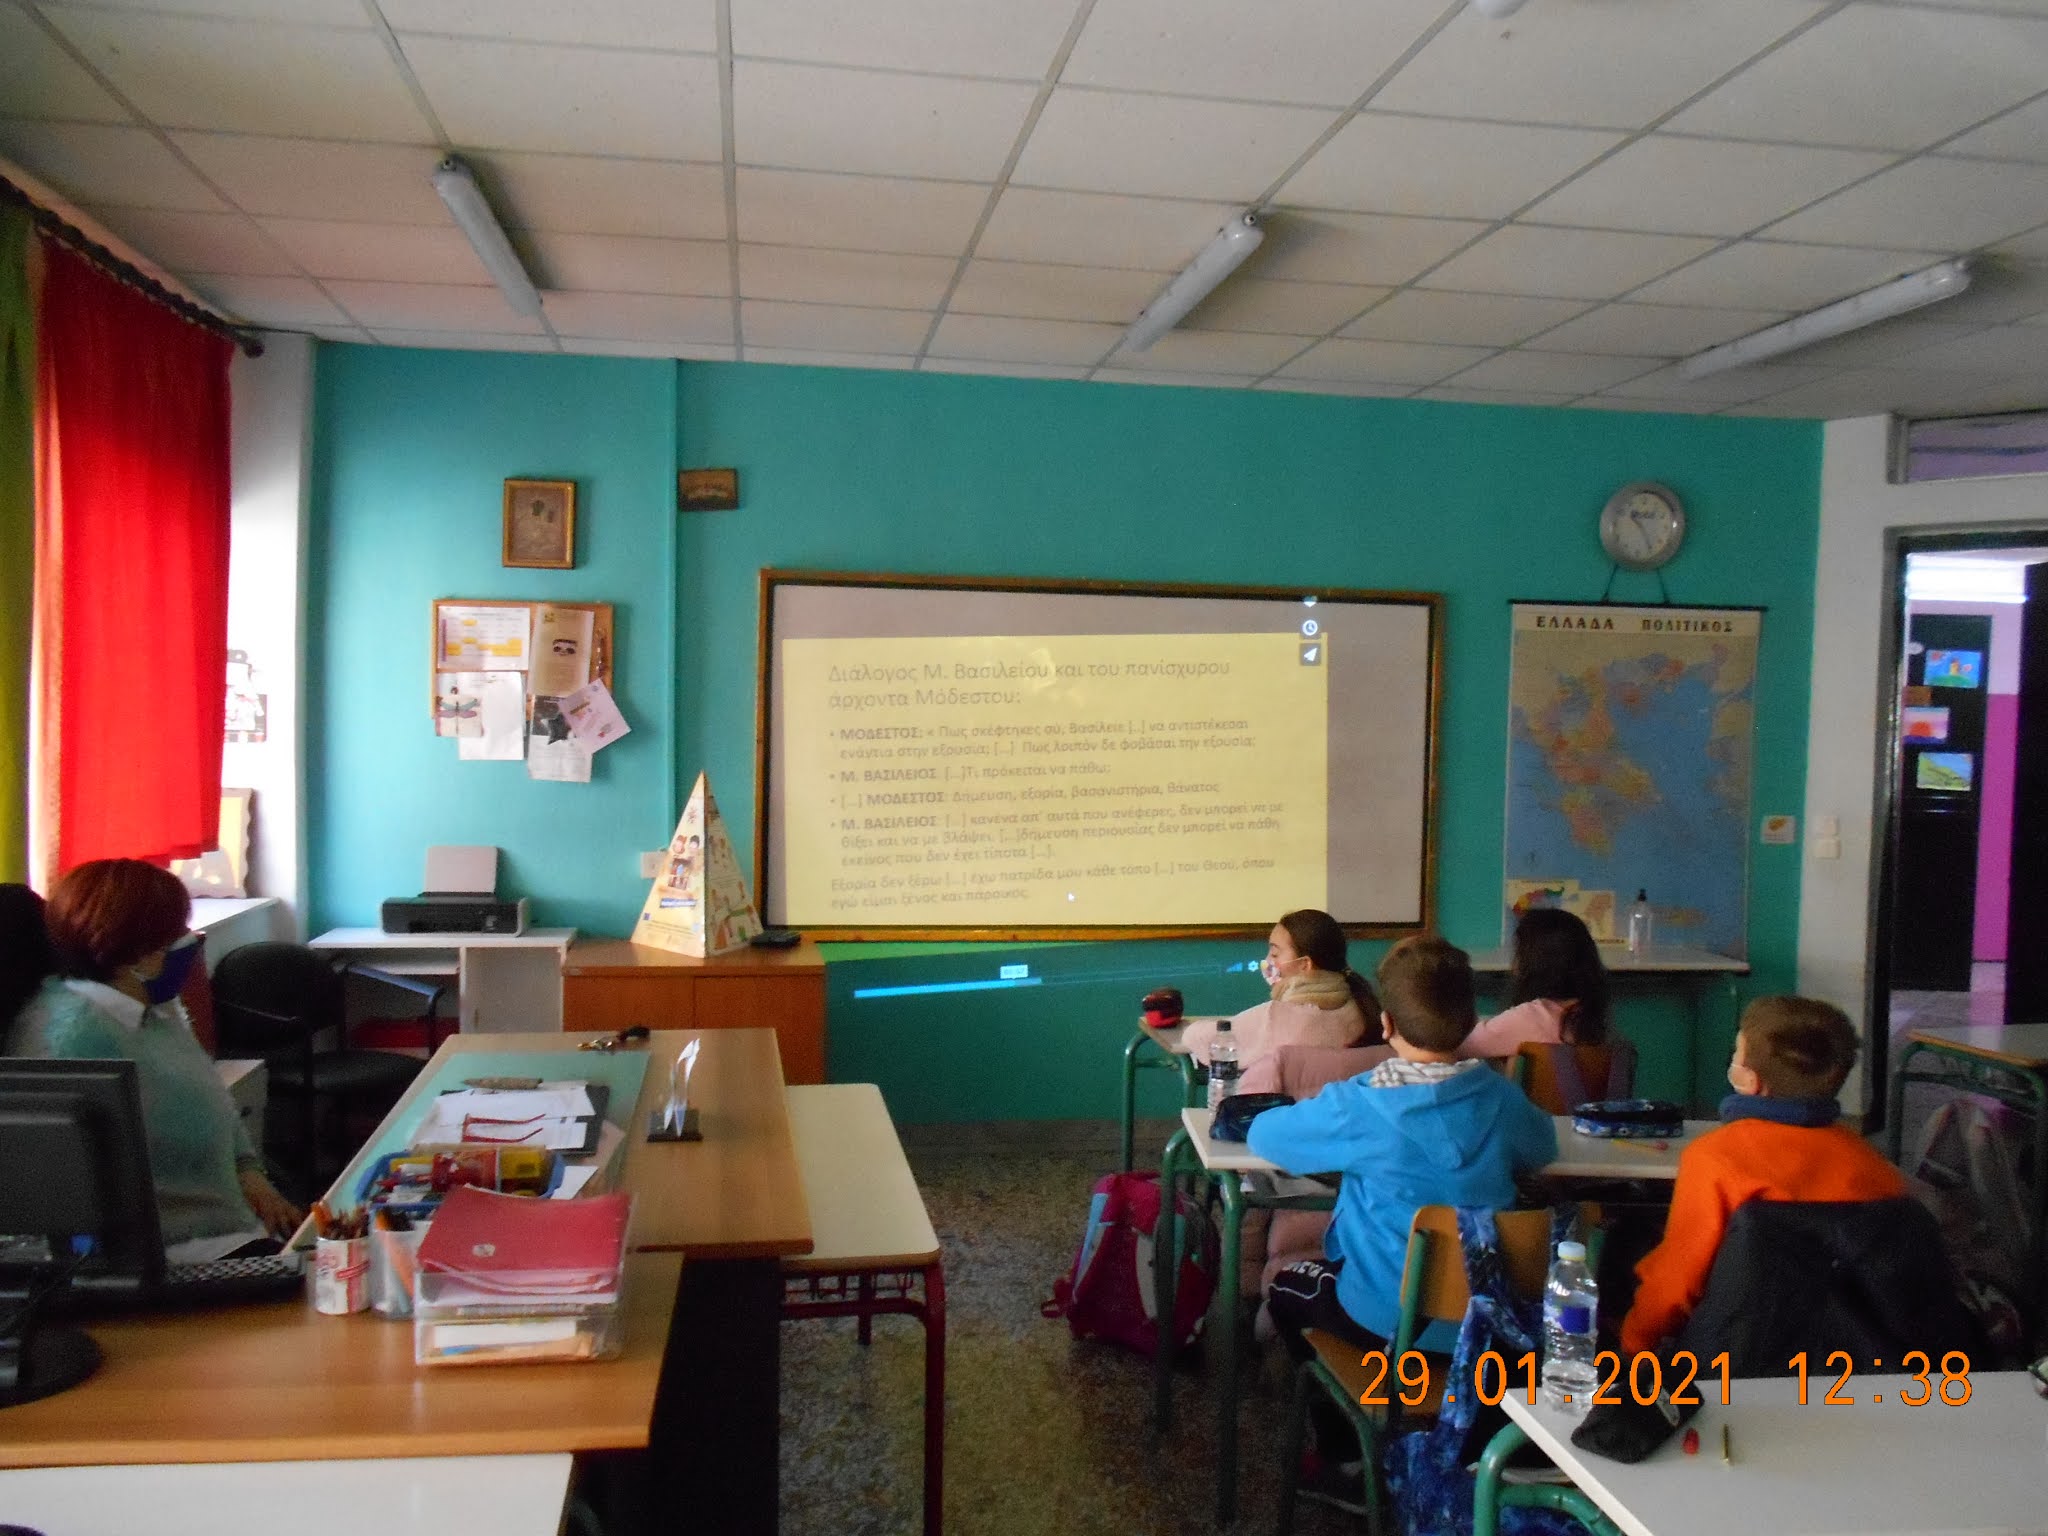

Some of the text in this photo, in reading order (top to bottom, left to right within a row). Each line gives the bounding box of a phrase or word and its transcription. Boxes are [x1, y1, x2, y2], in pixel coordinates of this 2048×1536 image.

[1536, 615, 1733, 633] ΕΛΛΑΔΑ ΠΟΛΙΤΙΚΟΣ
[828, 658, 1230, 684] Διάλογος Μ. Βασιλείου και του πανίσχυρου
[829, 691, 909, 711] άρχοντα
[972, 724, 1041, 738] σκέφτηκες
[1149, 722, 1165, 731] να
[897, 747, 928, 759] στην
[982, 764, 1047, 779] πρόκειται
[1049, 765, 1066, 776] να
[1083, 808, 1107, 820] που
[1179, 803, 1202, 816] δεν
[1158, 822, 1180, 835] δεν
[895, 854, 922, 865] που
[926, 849, 950, 862] δεν
[880, 875, 905, 889] δεν
